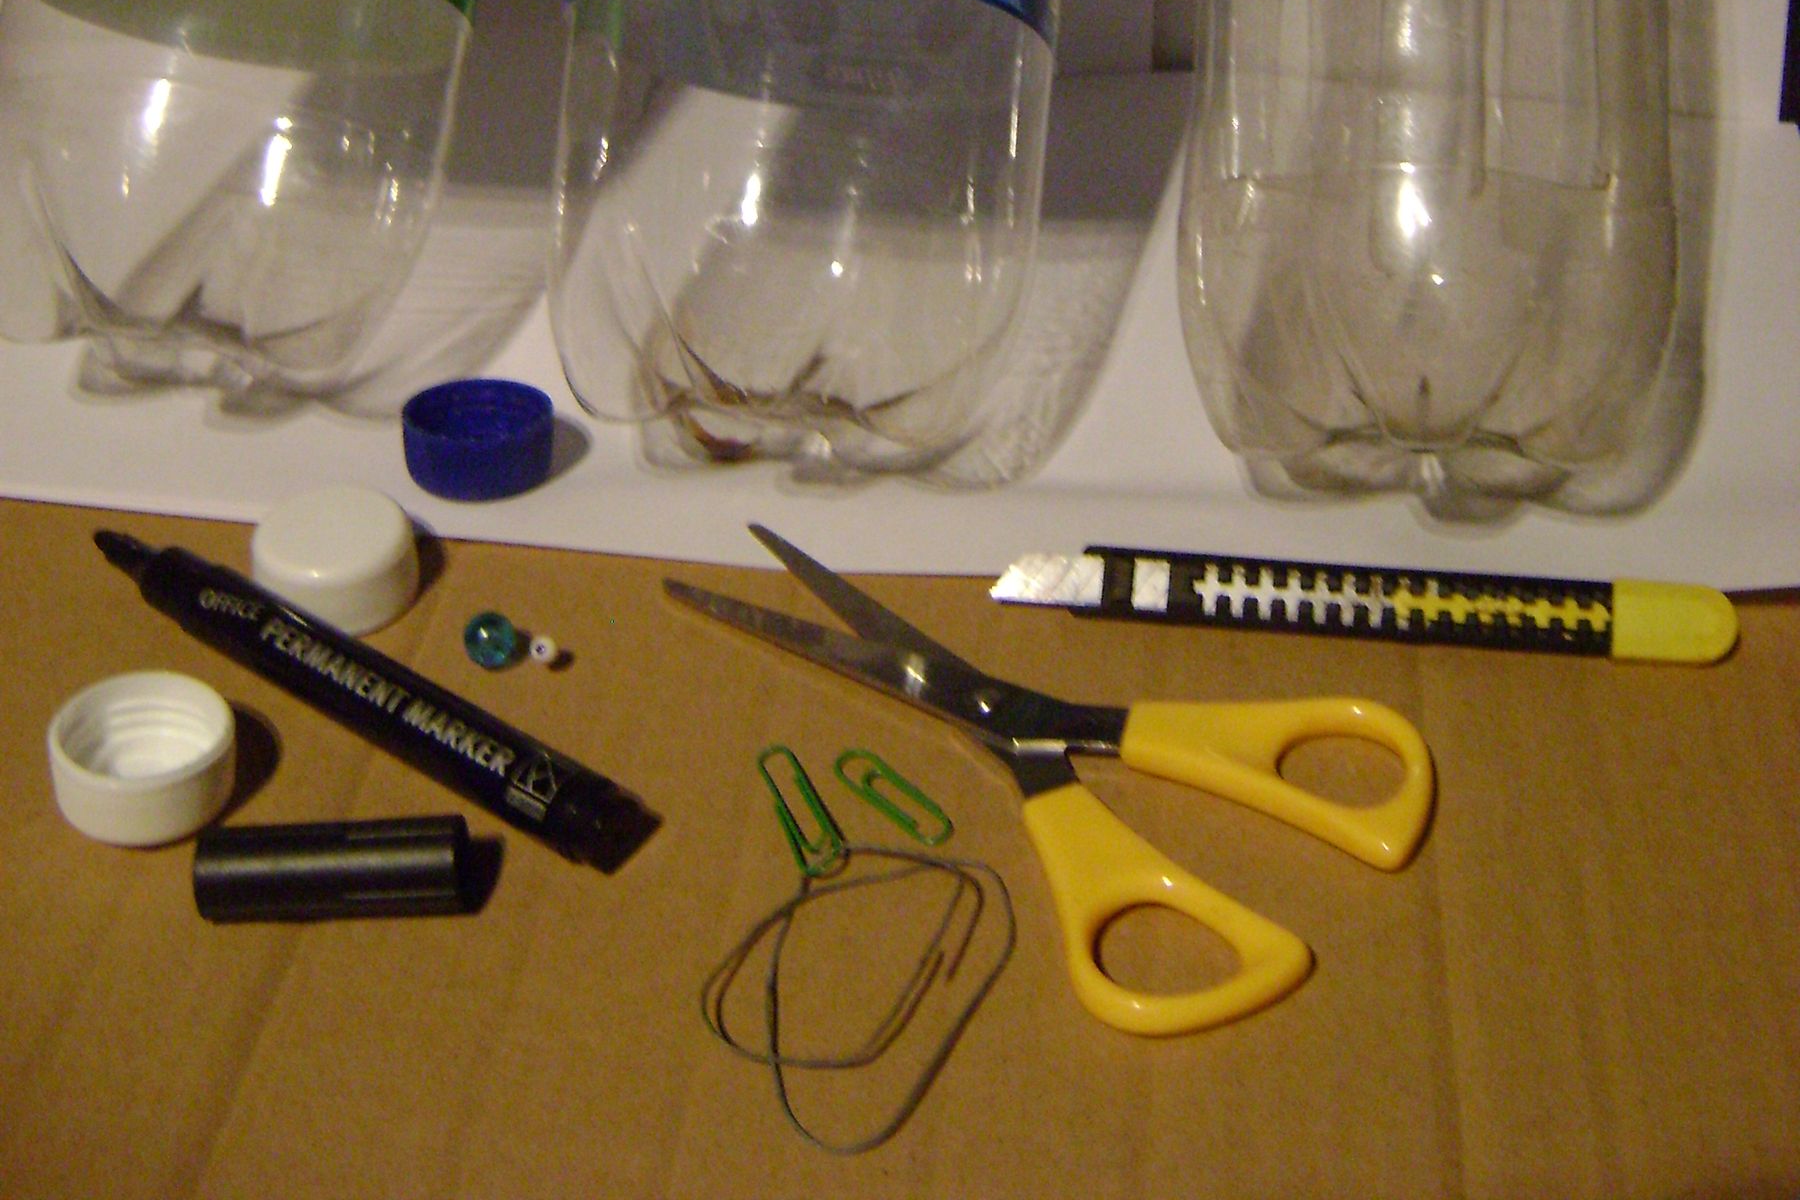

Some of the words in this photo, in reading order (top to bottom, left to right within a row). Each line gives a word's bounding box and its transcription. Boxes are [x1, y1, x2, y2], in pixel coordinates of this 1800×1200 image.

[200, 588, 262, 623] OFFICE
[260, 617, 411, 714] PERMANENT
[402, 698, 516, 778] MARKER
